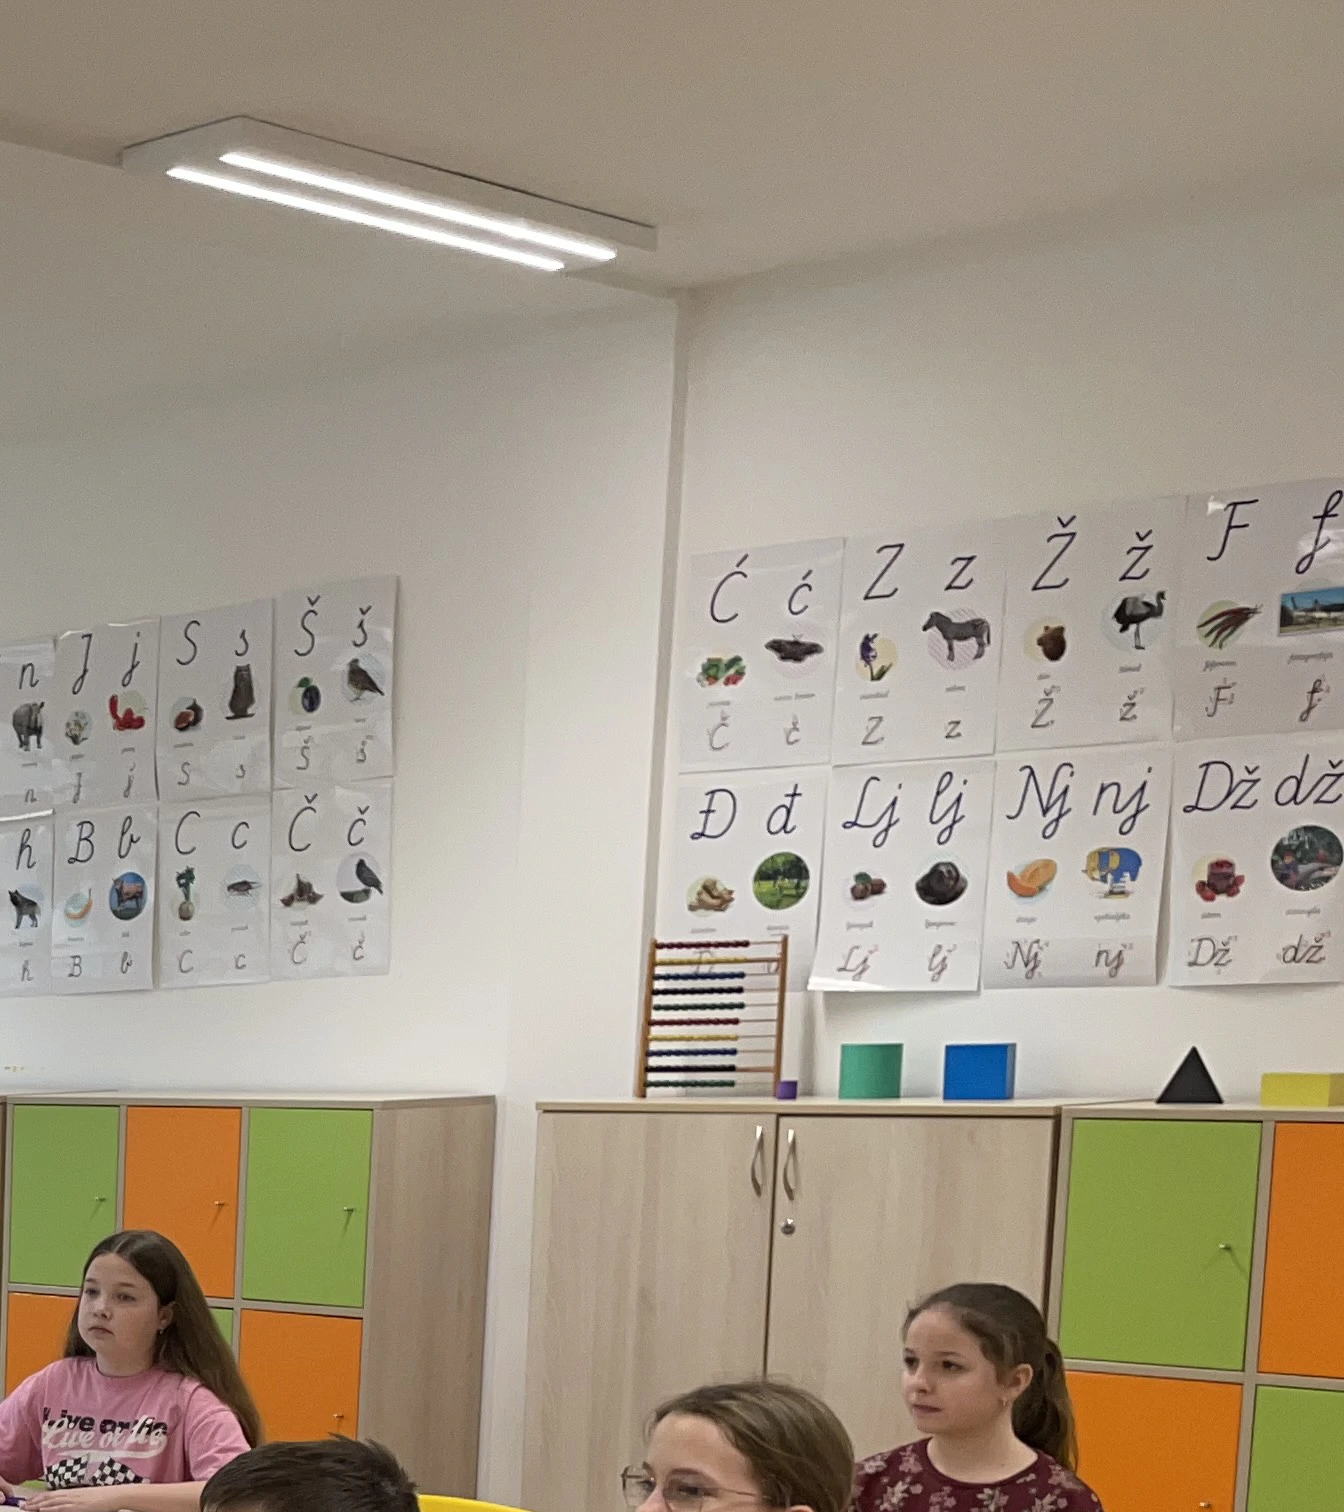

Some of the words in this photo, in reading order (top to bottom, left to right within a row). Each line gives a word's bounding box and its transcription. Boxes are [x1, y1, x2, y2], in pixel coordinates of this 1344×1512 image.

[1031, 515, 1077, 591] Ž
[1119, 529, 1153, 581] ž
[1207, 499, 1259, 561] F
[1295, 490, 1343, 574] f
[710, 554, 749, 623] Ć
[788, 570, 812, 615] ć
[863, 543, 904, 600] Z
[944, 555, 976, 591] z
[176, 620, 200, 665] S
[235, 630, 249, 656] s
[294, 595, 320, 656] Š
[352, 606, 371, 647] š
[19, 663, 39, 689] n
[72, 633, 92, 695] J
[122, 632, 140, 687] j
[690, 789, 736, 840] Đ
[767, 784, 802, 835] đ
[842, 776, 902, 848] Lj
[929, 771, 967, 845] lj
[1006, 762, 1074, 839] Nj
[1093, 767, 1152, 835] nj
[1183, 761, 1261, 813] Dž
[1275, 754, 1344, 806] dž
[16, 828, 36, 870] h
[68, 821, 94, 864] B
[118, 816, 140, 859] b
[175, 811, 200, 855] C
[232, 822, 249, 849] c
[288, 794, 318, 852] Č
[347, 806, 369, 846] č
